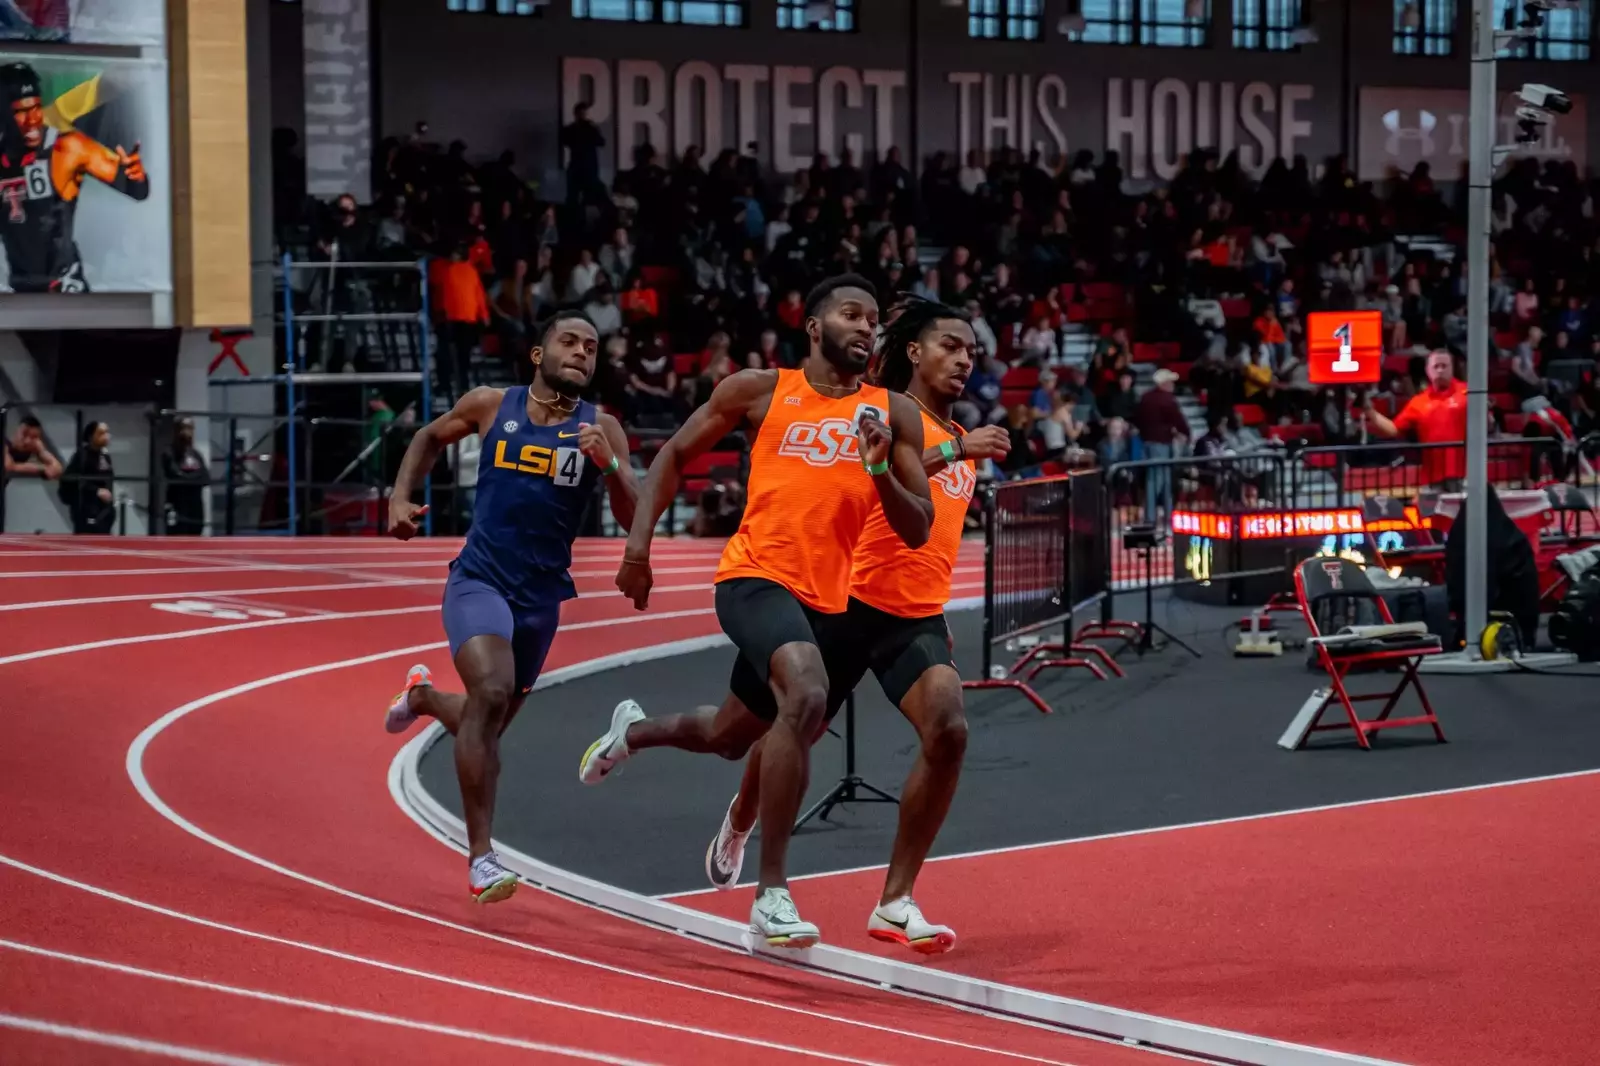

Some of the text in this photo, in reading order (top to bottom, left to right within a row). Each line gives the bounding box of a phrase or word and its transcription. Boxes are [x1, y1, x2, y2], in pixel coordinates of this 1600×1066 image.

[562, 56, 906, 174] PROTECT
[948, 72, 1068, 178] THIS
[29, 168, 46, 194] 6
[1331, 322, 1360, 372] 1
[560, 451, 578, 485] 4
